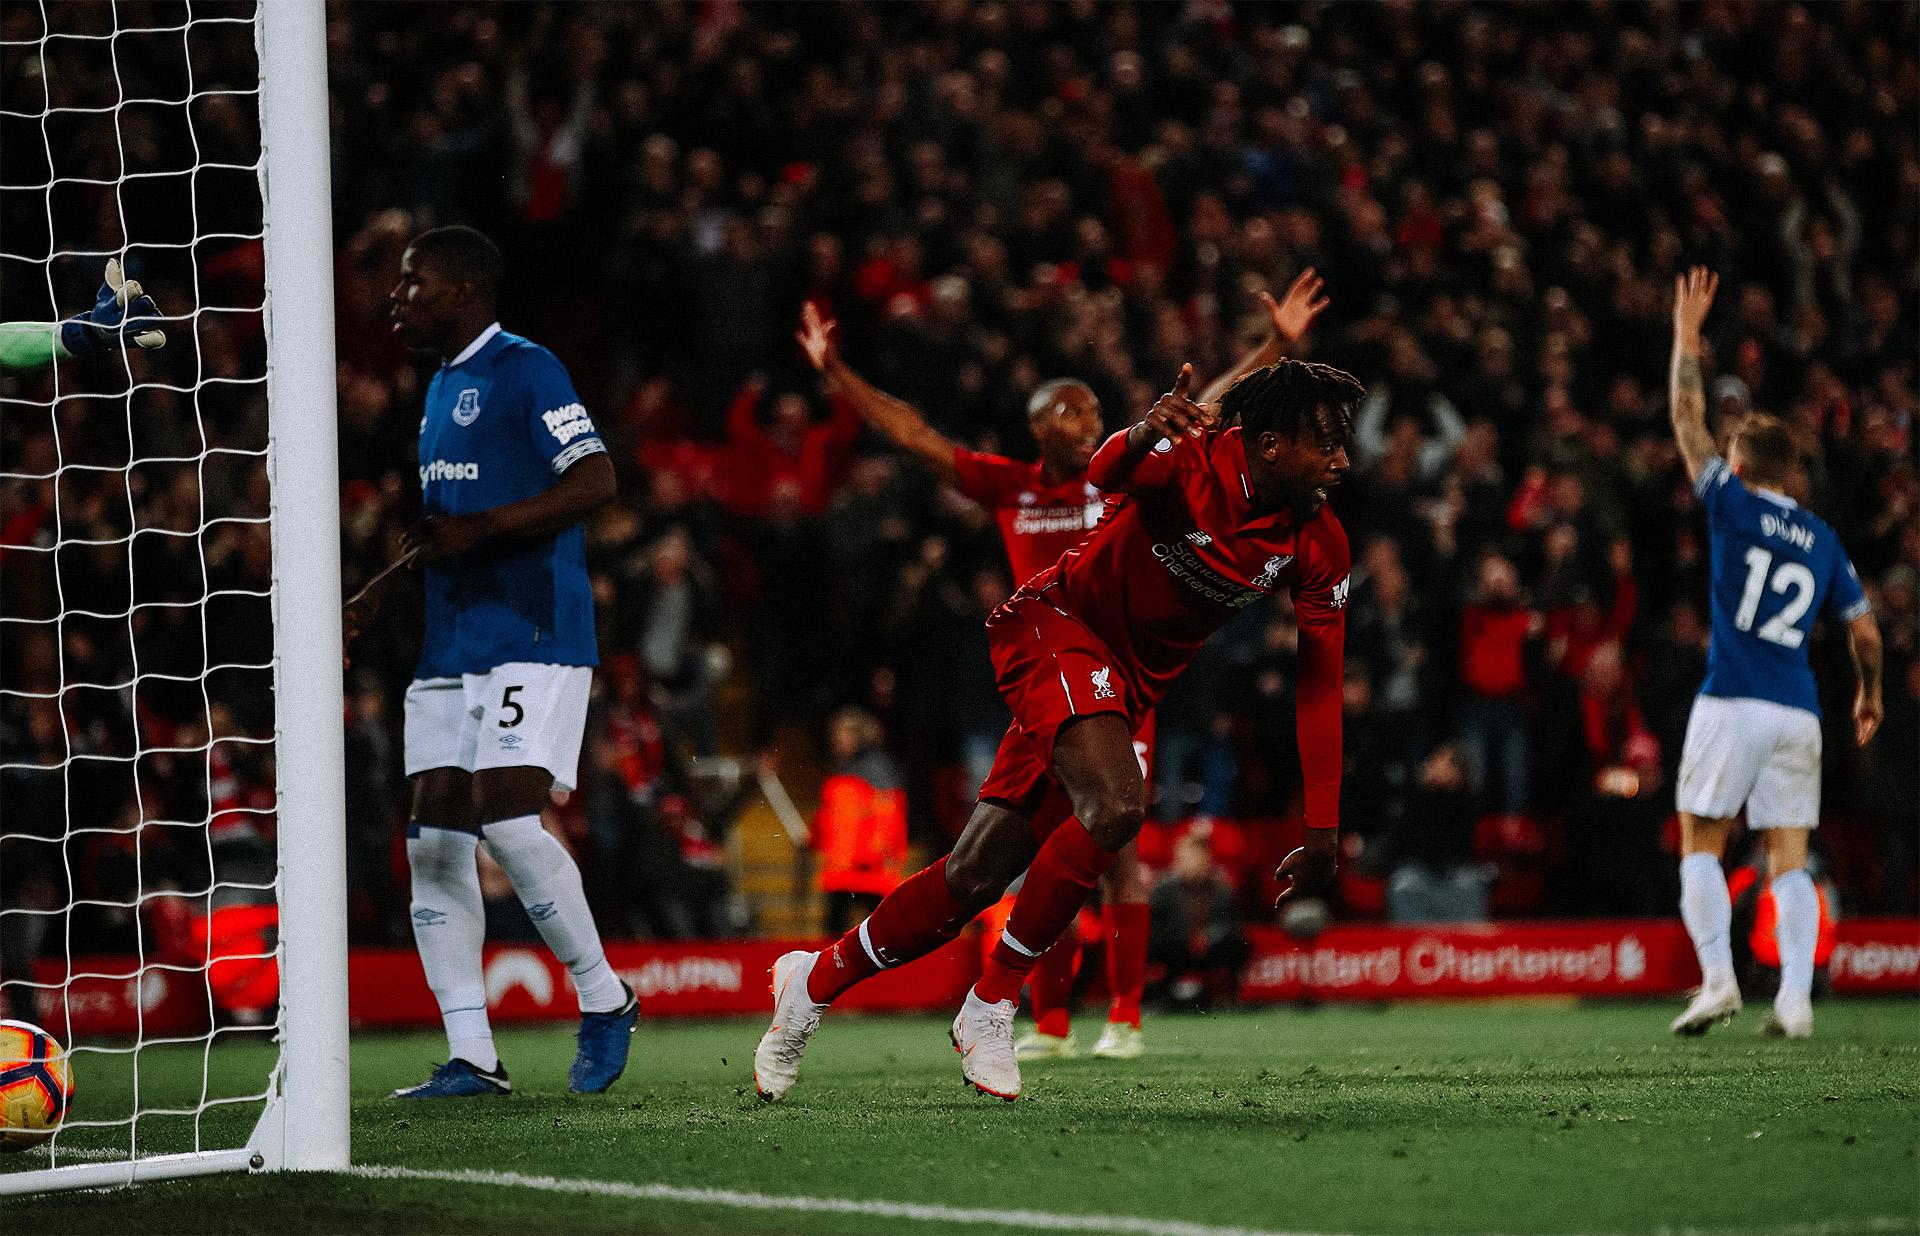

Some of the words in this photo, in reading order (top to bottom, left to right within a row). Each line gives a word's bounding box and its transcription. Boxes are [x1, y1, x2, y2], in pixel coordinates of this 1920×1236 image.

[1151, 543, 1232, 602] Chartered
[1735, 546, 1816, 650] 12
[498, 685, 524, 729] 5
[1406, 935, 1613, 985] Chartered
